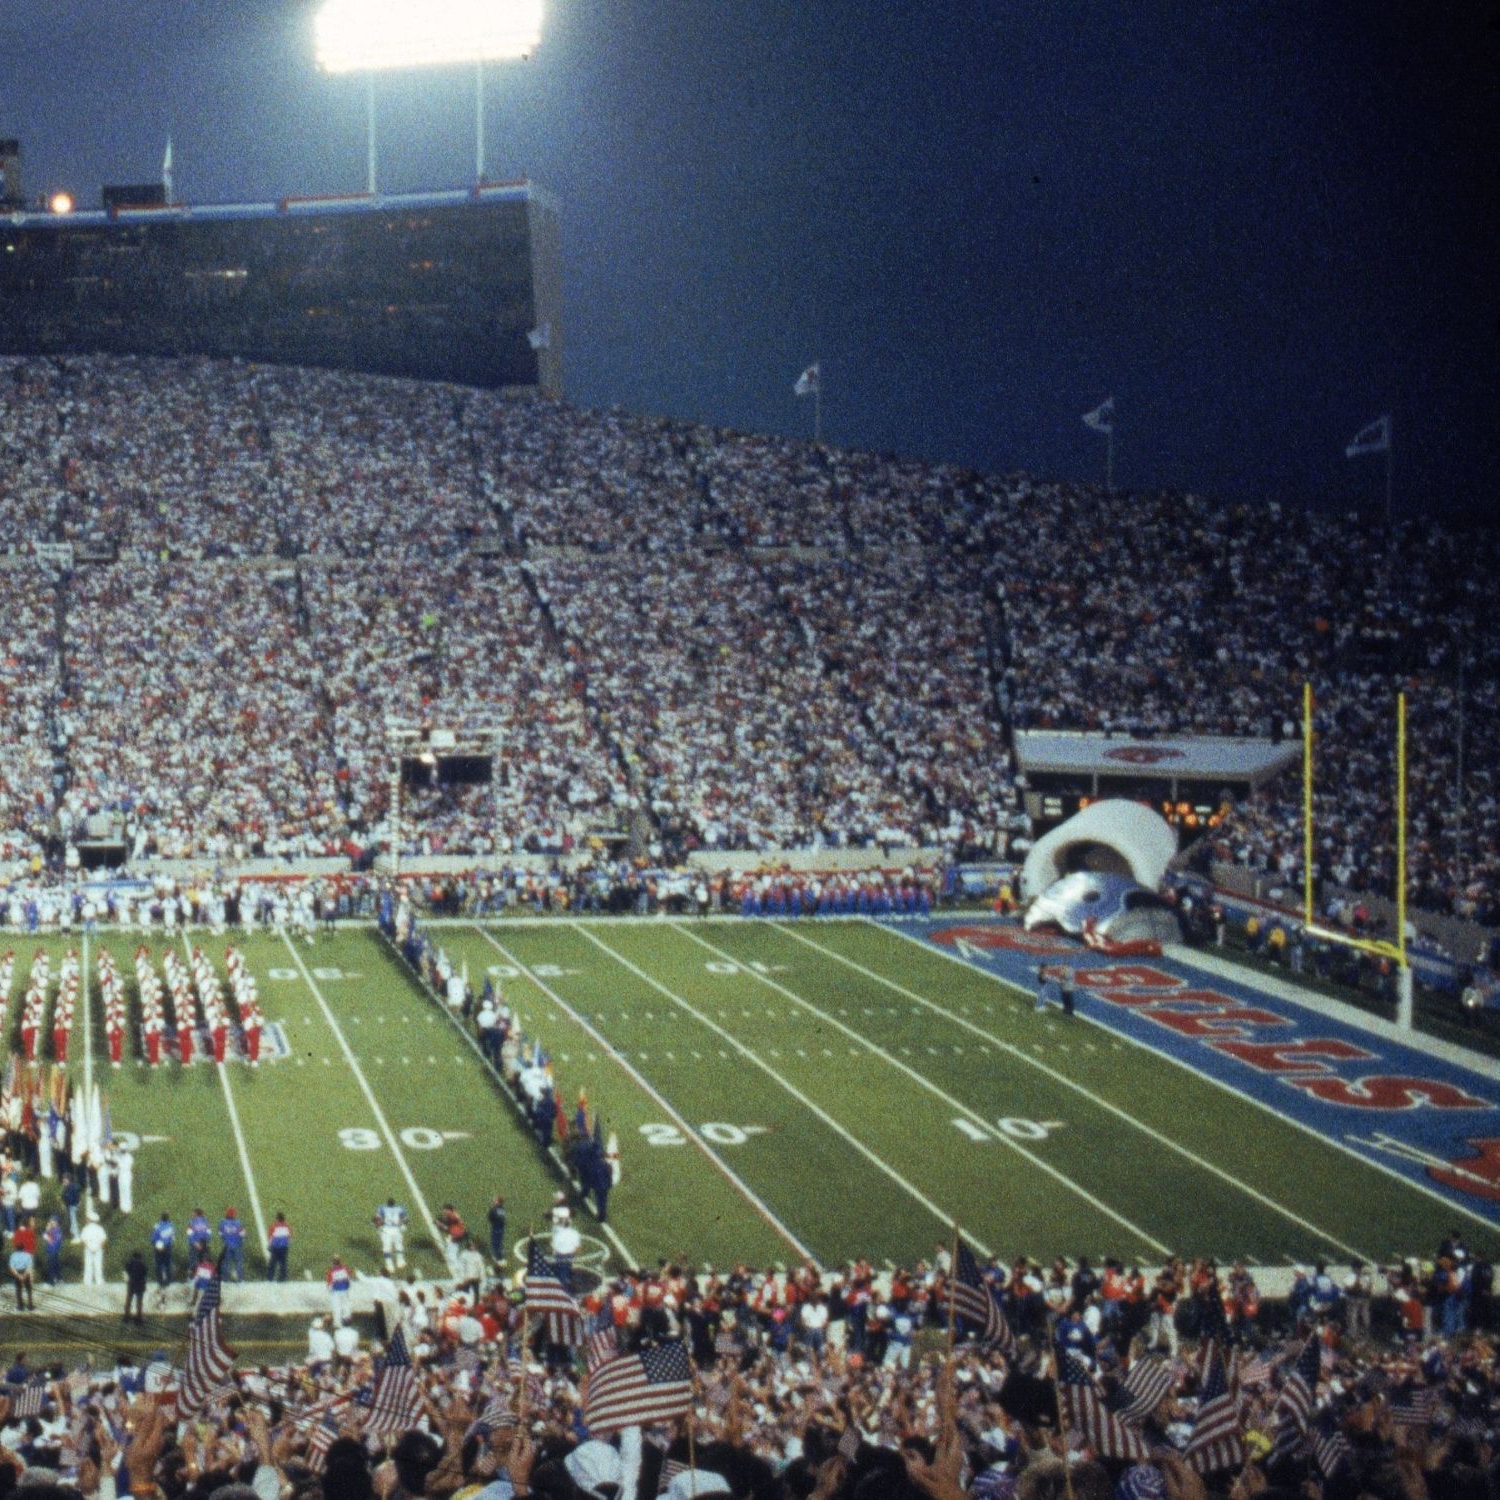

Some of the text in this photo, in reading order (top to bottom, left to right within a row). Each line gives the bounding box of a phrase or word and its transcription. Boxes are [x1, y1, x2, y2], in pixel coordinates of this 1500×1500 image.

[1030, 963, 1498, 1111] BILLS
[336, 1127, 444, 1150] 30
[638, 1122, 748, 1146] 20
[950, 1117, 1049, 1142] 10
